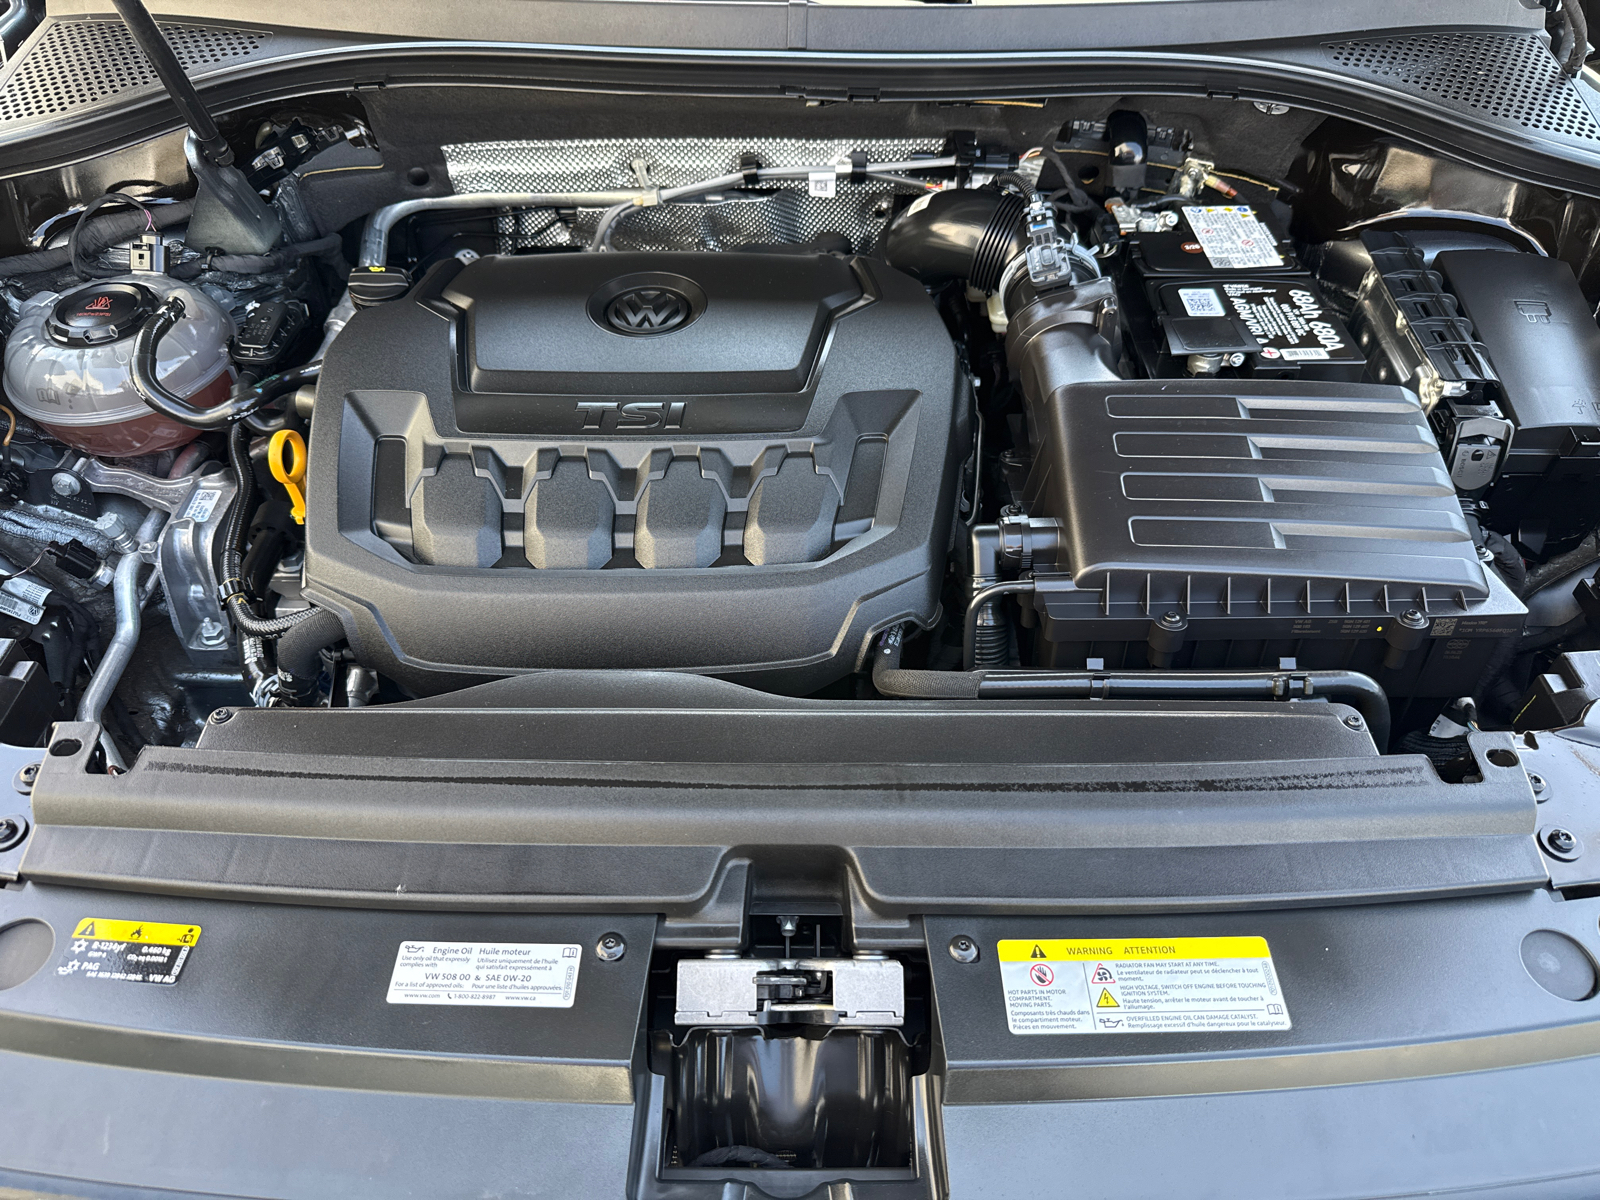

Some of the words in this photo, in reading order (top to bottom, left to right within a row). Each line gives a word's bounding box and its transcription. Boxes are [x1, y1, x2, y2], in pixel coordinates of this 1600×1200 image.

[1289, 289, 1323, 319] 68Ah
[1309, 321, 1345, 352] 680A
[574, 402, 687, 430] TSI
[162, 946, 172, 956] kg
[432, 947, 459, 955] Engine
[479, 948, 500, 956] Huile
[1066, 947, 1113, 955] WARNING
[1124, 946, 1176, 955] ATTENTION
[81, 962, 100, 970] PAG
[442, 973, 457, 981] 508
[459, 973, 471, 981] 00
[485, 974, 502, 982] SAE
